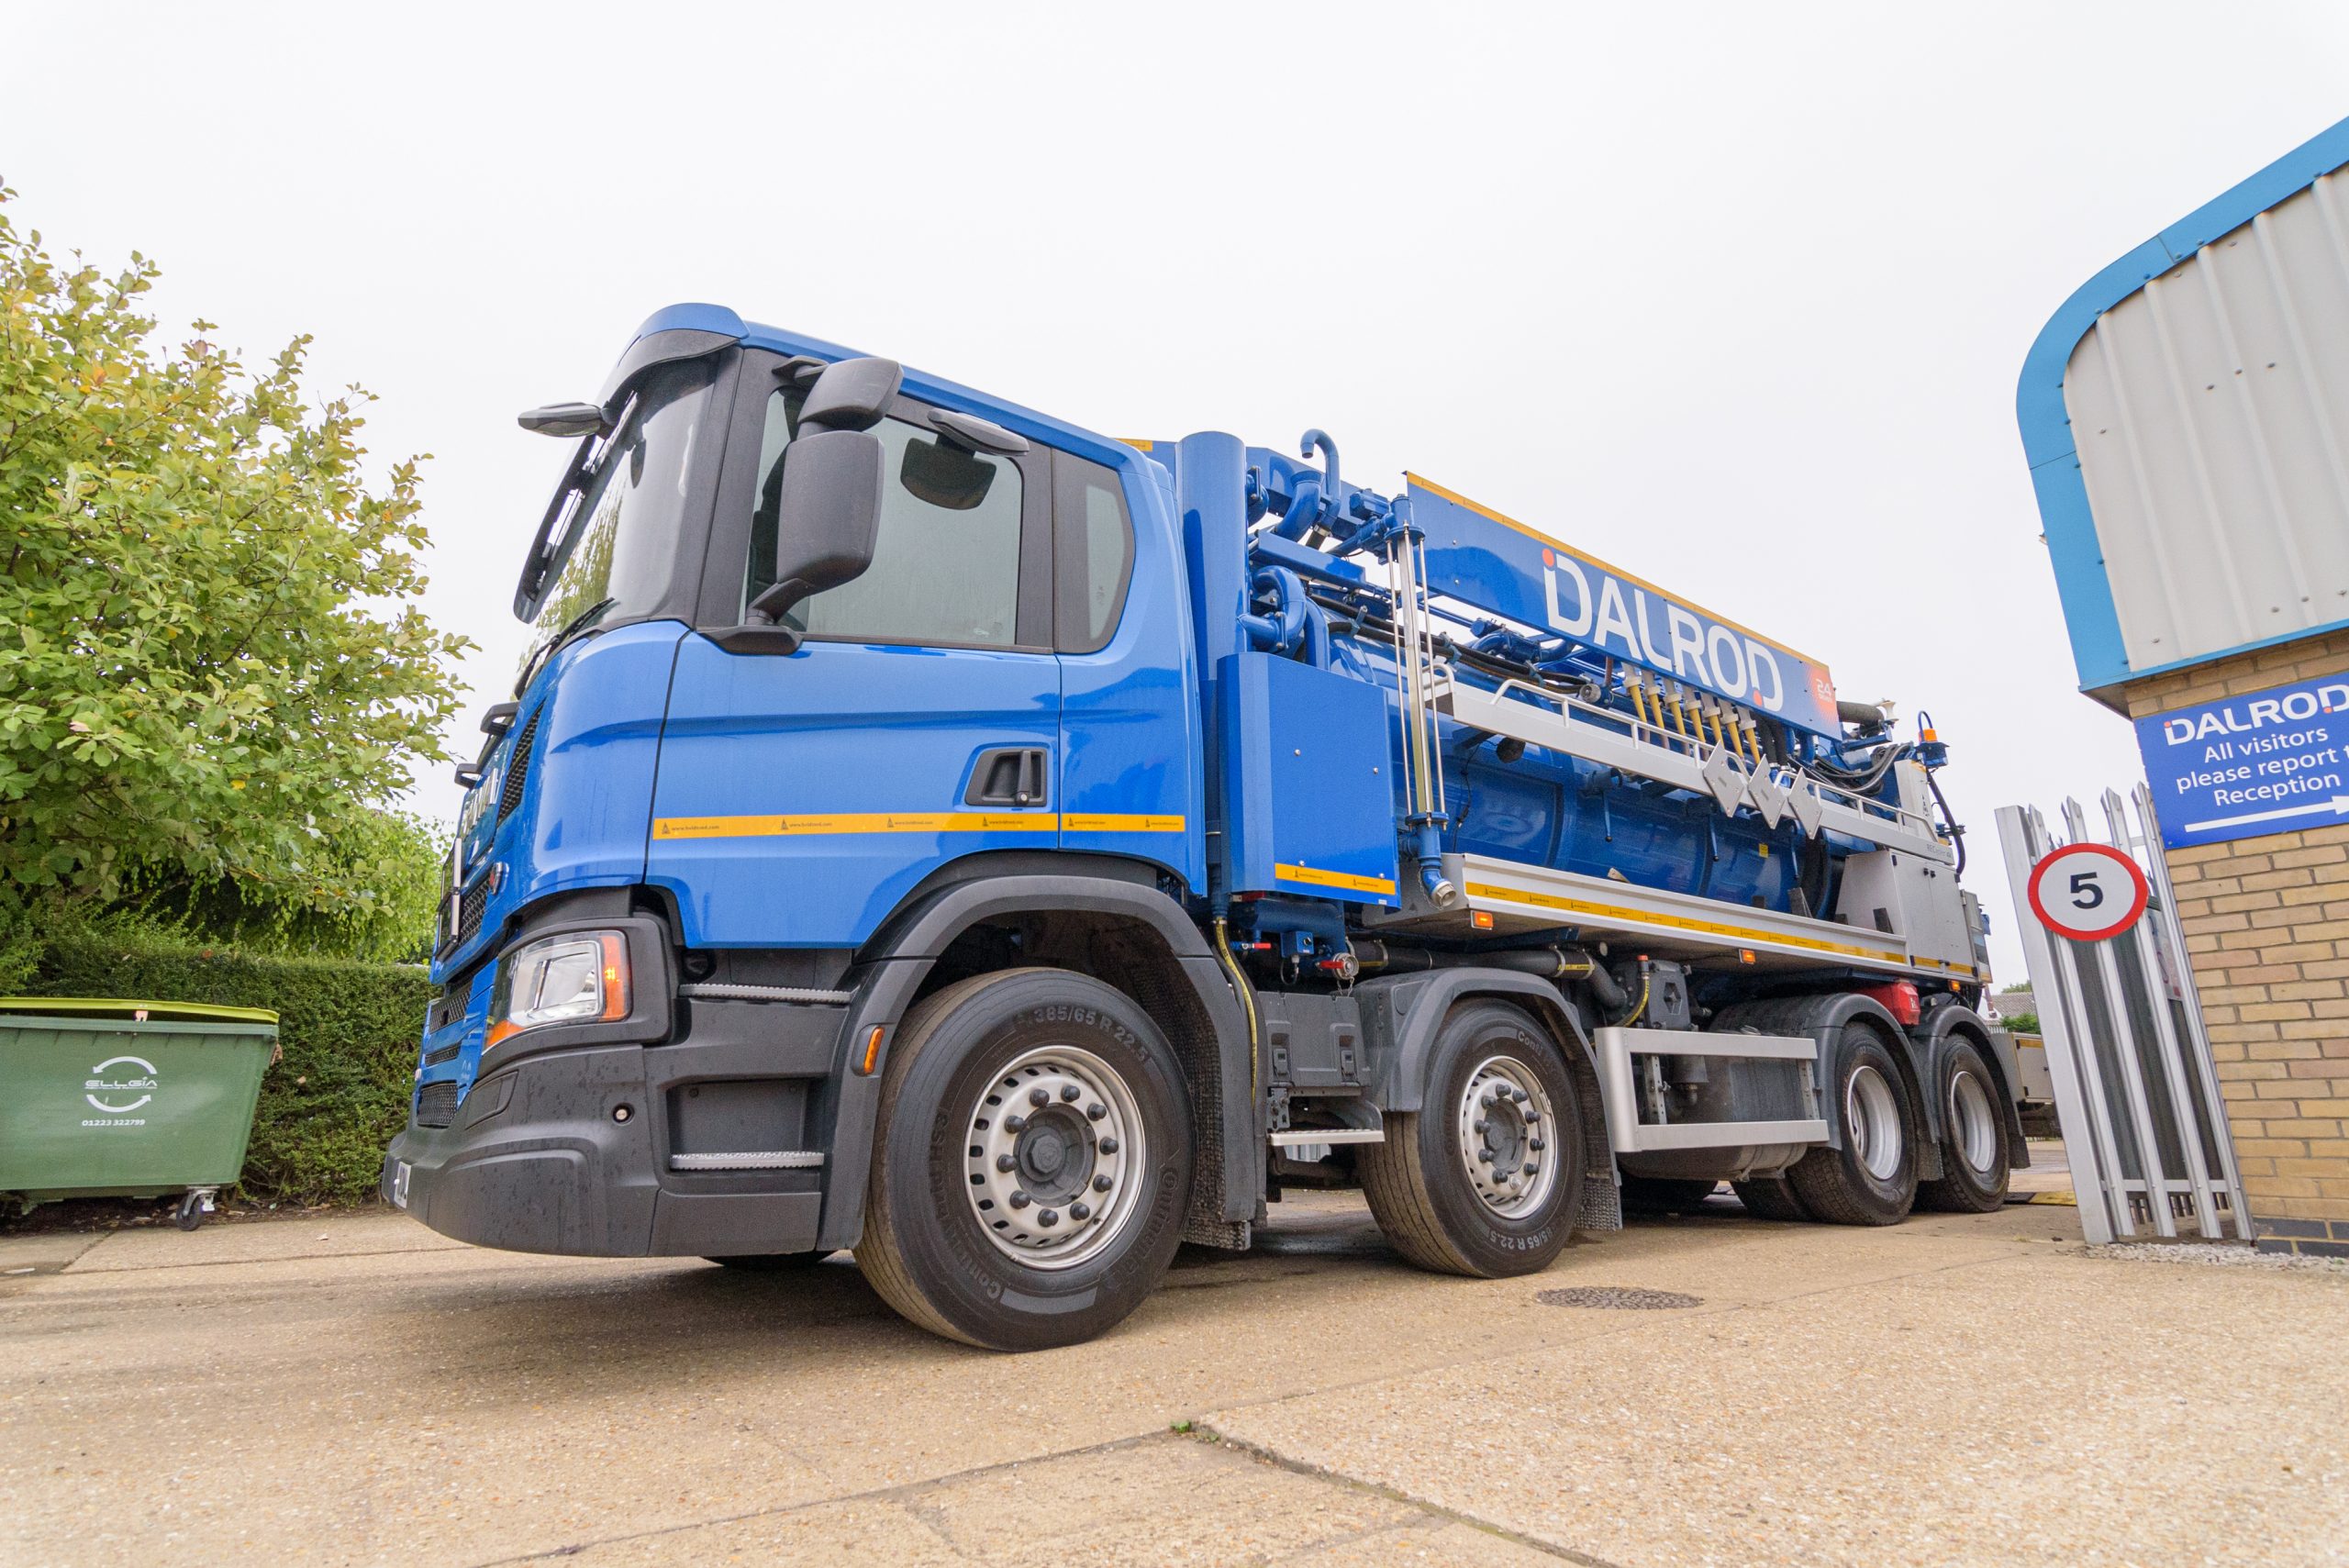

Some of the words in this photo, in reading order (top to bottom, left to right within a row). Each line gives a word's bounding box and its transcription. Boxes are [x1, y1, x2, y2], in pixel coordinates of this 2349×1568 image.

[1542, 548, 1784, 712] DALROD
[2164, 684, 2349, 746] DALROD
[2204, 742, 2234, 763] All
[2239, 728, 2329, 756] visitors
[2176, 765, 2252, 795] please
[2257, 748, 2340, 775] report
[2213, 773, 2342, 806] Reception
[2070, 872, 2103, 909] 5
[1034, 1006, 1097, 1026] 385/65
[1100, 1015, 1113, 1031] R
